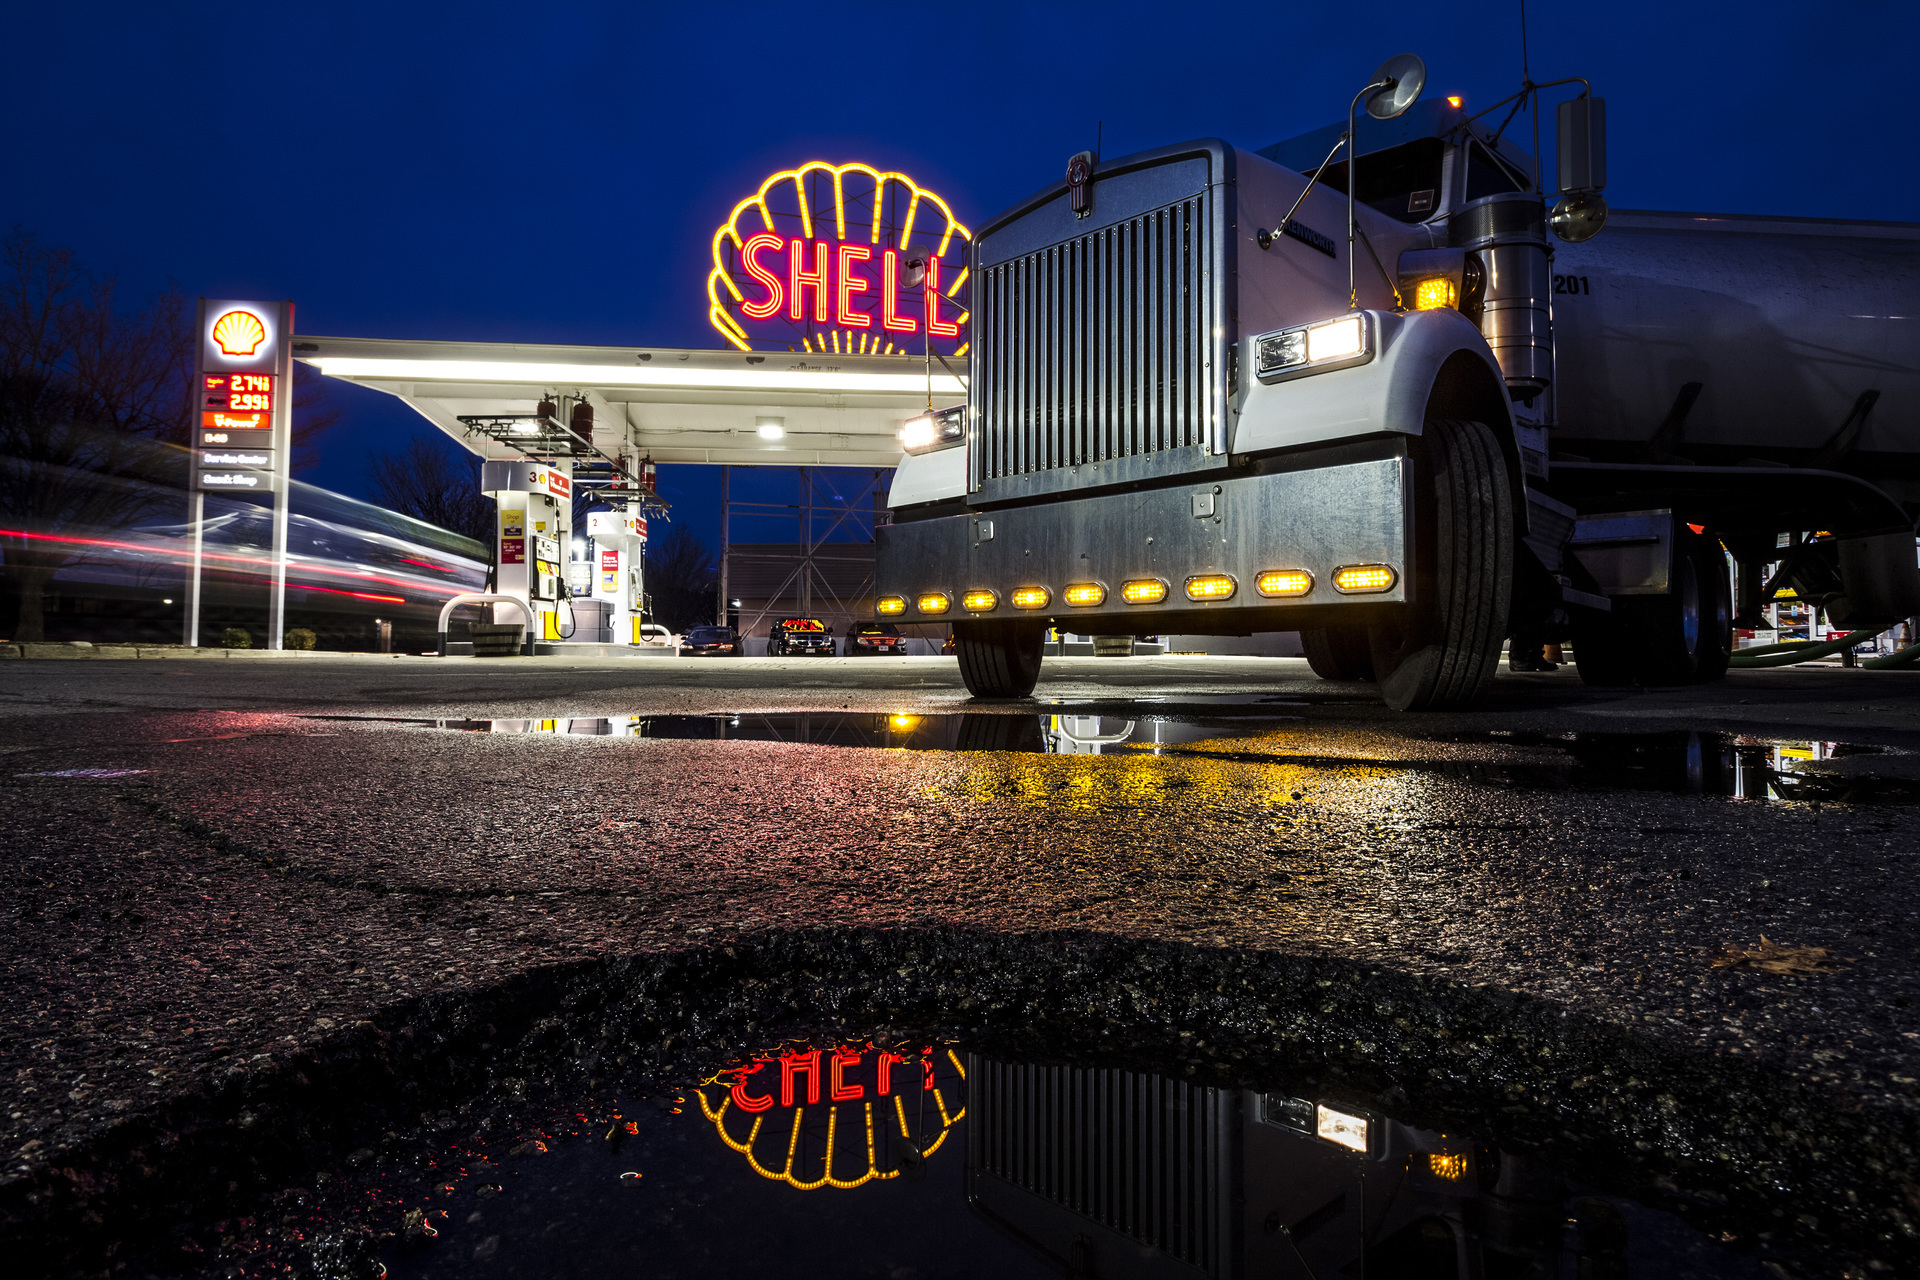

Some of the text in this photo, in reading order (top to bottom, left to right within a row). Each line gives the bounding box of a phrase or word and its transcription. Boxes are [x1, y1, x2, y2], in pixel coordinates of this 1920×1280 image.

[740, 232, 960, 337] SHELL
[1554, 275, 1589, 295] 201
[529, 471, 537, 483] 3
[592, 518, 598, 527] 2
